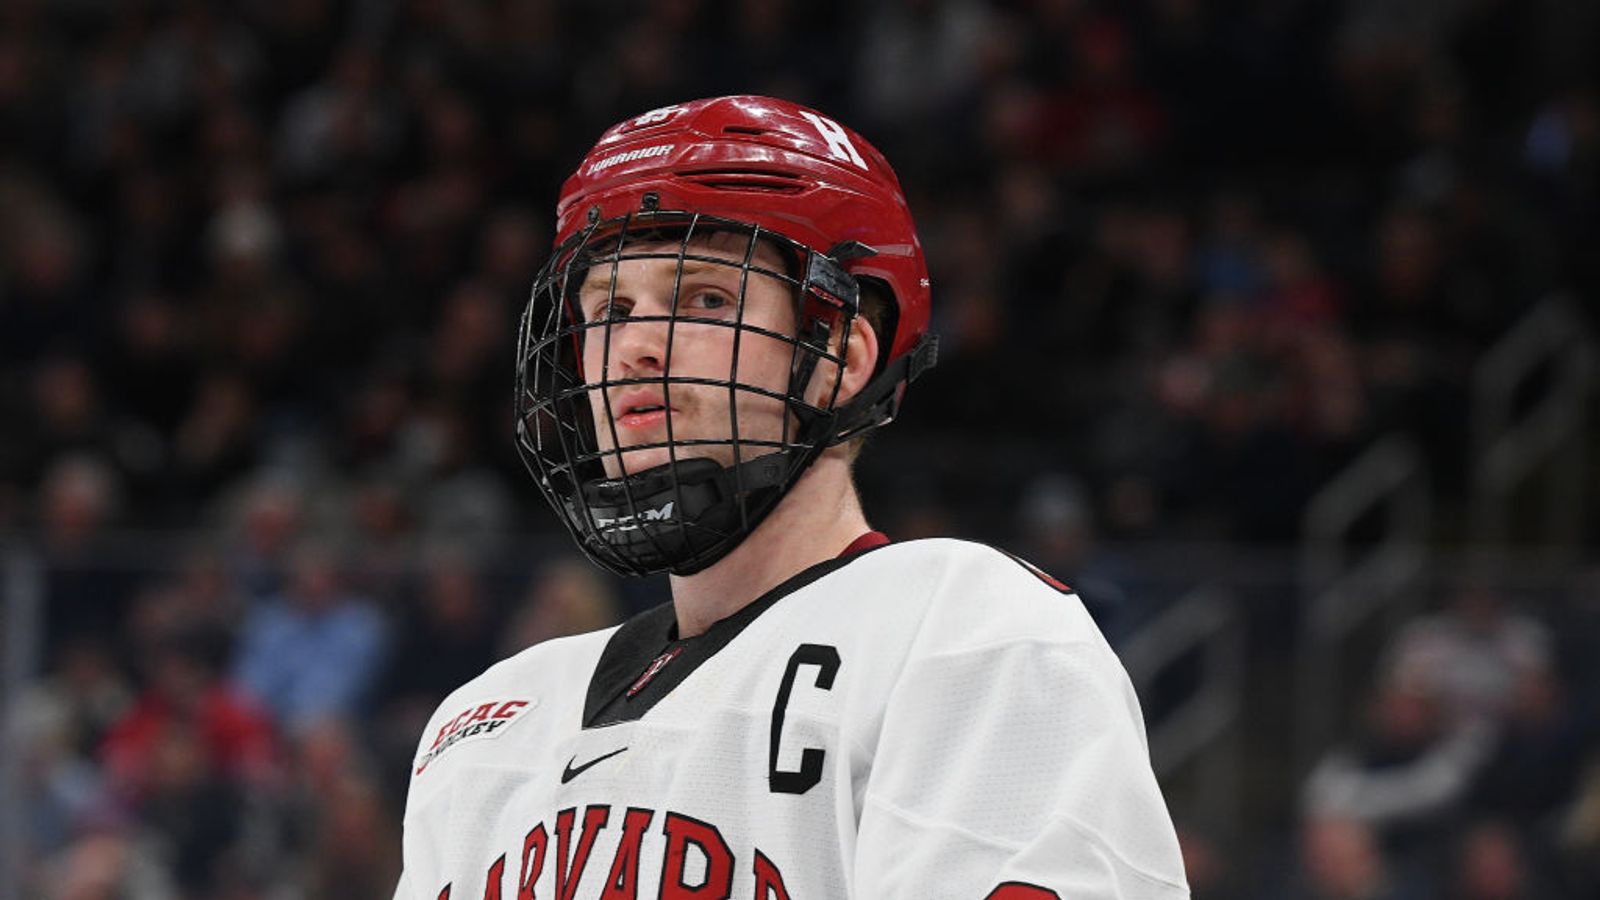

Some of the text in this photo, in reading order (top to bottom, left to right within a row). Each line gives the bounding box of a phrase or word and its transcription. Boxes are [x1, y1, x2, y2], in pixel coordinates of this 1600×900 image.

[586, 144, 675, 176] WARRIOR
[798, 109, 869, 171] H
[430, 700, 529, 752] ECAC
[769, 643, 841, 795] C
[437, 804, 792, 900] RVAR
